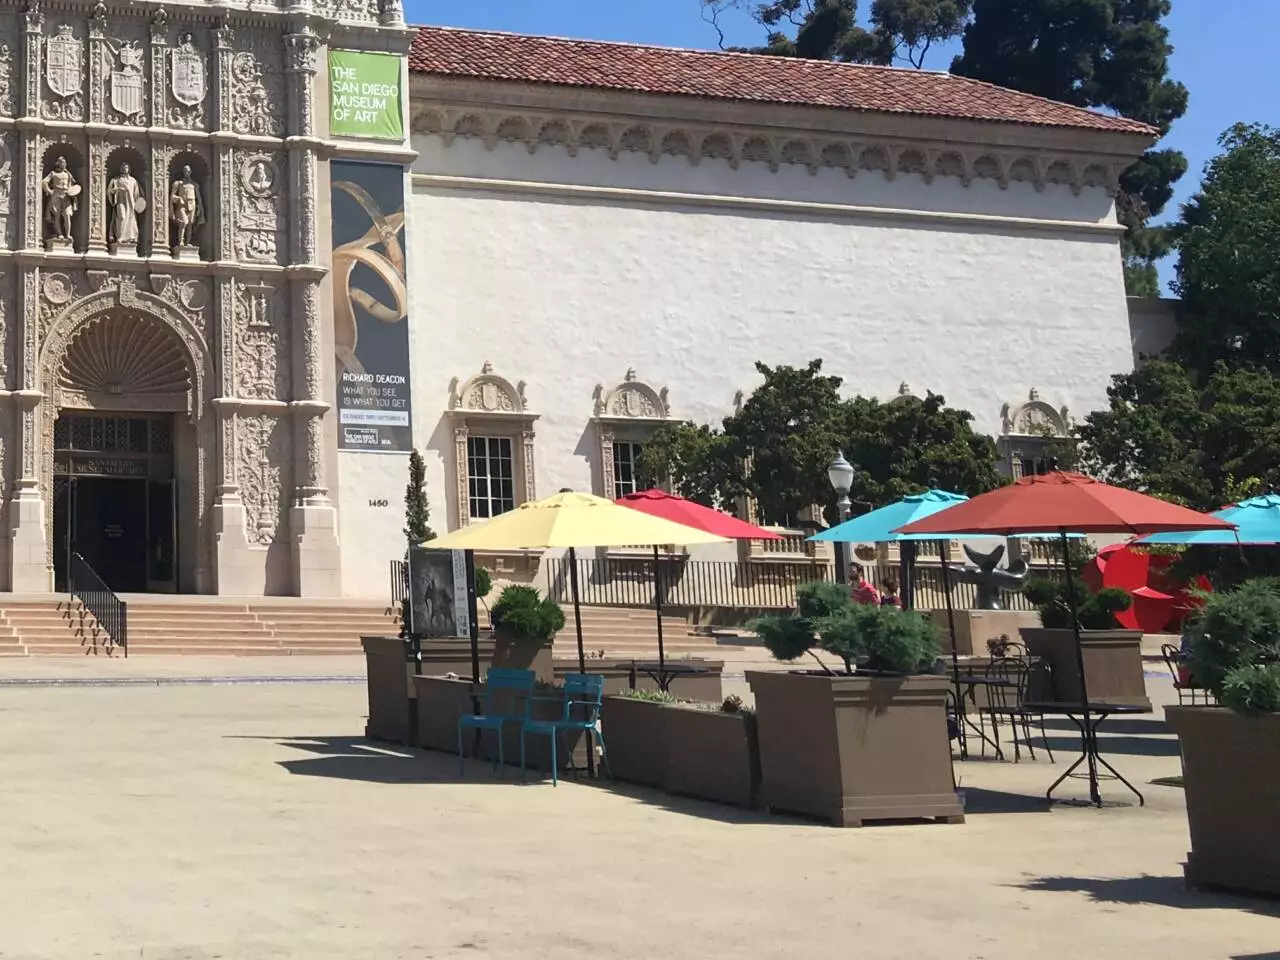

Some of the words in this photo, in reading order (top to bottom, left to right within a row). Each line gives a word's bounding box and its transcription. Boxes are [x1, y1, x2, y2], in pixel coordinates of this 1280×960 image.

[332, 66, 357, 80] THE
[332, 81, 359, 94] SAN
[362, 83, 398, 97] DIEGO
[333, 95, 386, 110] MUSEUM
[333, 109, 350, 121] OF
[354, 111, 378, 123] ART
[342, 373, 374, 383] RICHARD
[376, 374, 406, 384] DEACON
[342, 386, 364, 394] WHAT
[367, 387, 381, 396] YOU
[382, 387, 397, 397] SEE
[343, 397, 351, 406] IS
[353, 398, 373, 406] WHAT
[376, 399, 390, 407] YOU
[392, 399, 406, 408] GET
[368, 499, 388, 507] 1450
